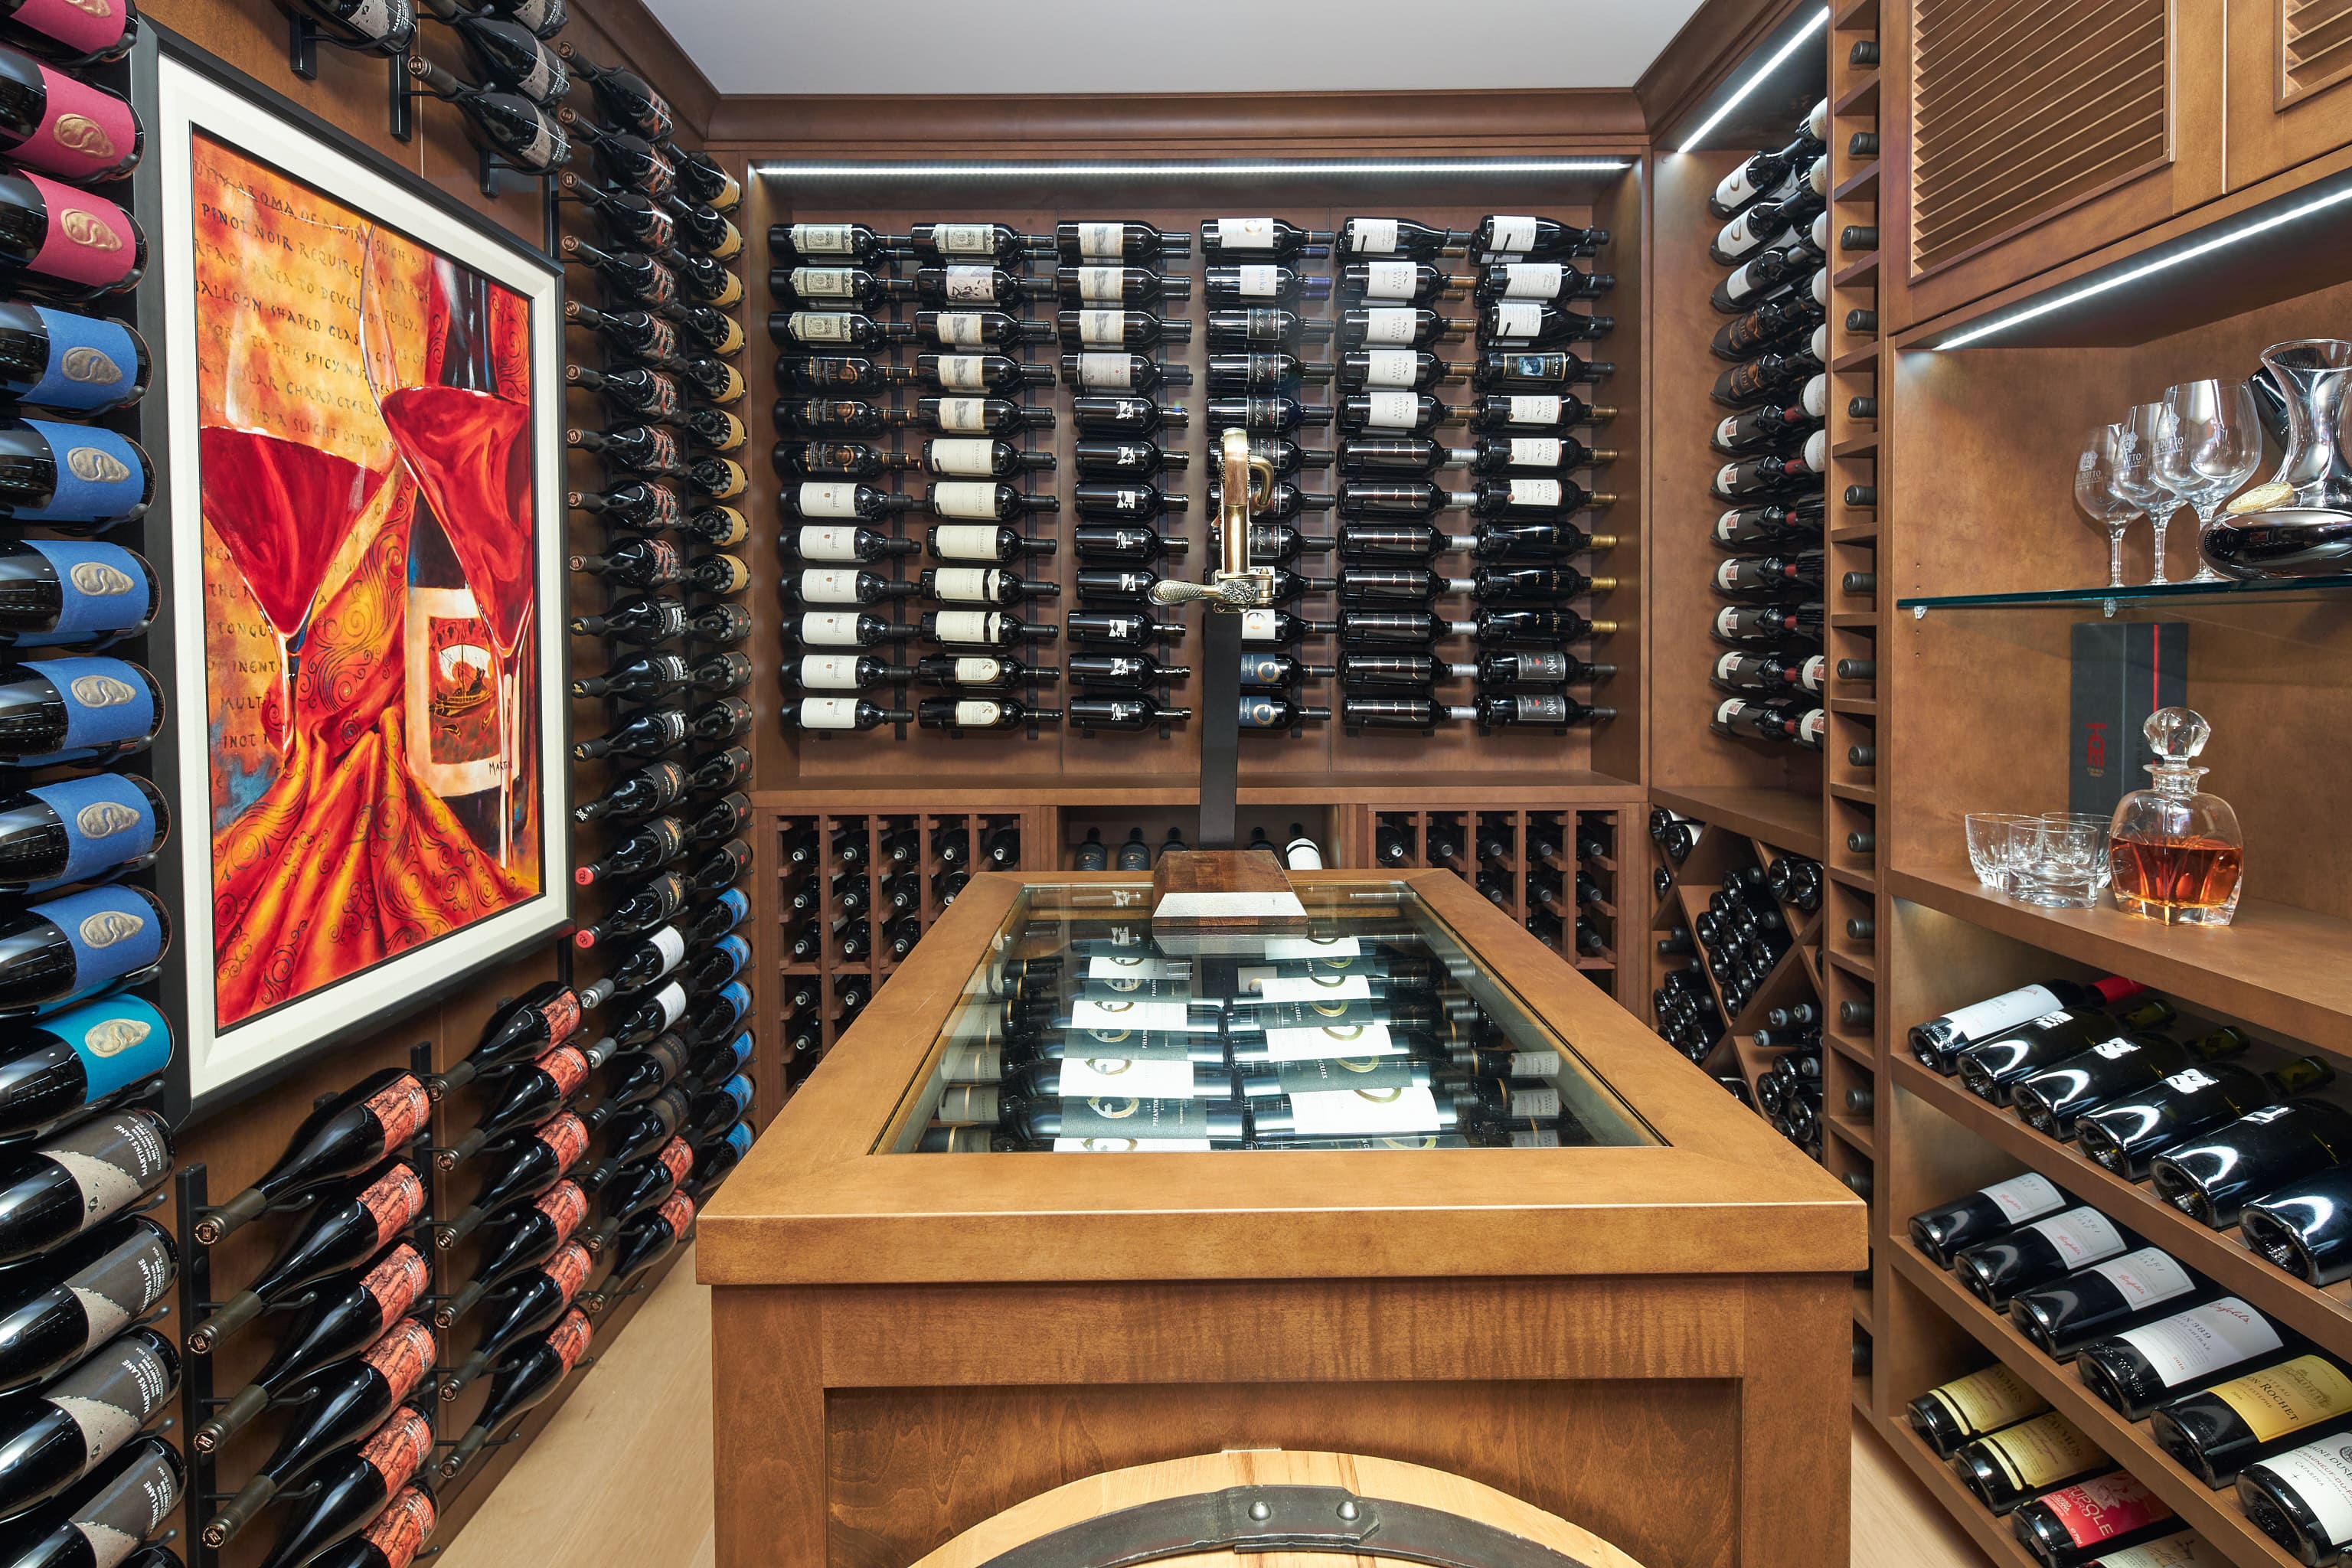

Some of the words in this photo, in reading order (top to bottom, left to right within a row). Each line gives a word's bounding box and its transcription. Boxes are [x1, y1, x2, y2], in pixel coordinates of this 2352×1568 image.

[238, 181, 297, 220] AROMA
[202, 203, 247, 233] PINOT
[255, 225, 293, 251] NOIR
[113, 1124, 136, 1142] LANE
[138, 1258, 152, 1281] LANE
[122, 1359, 142, 1378] LANE
[143, 1481, 157, 1503] LANE
